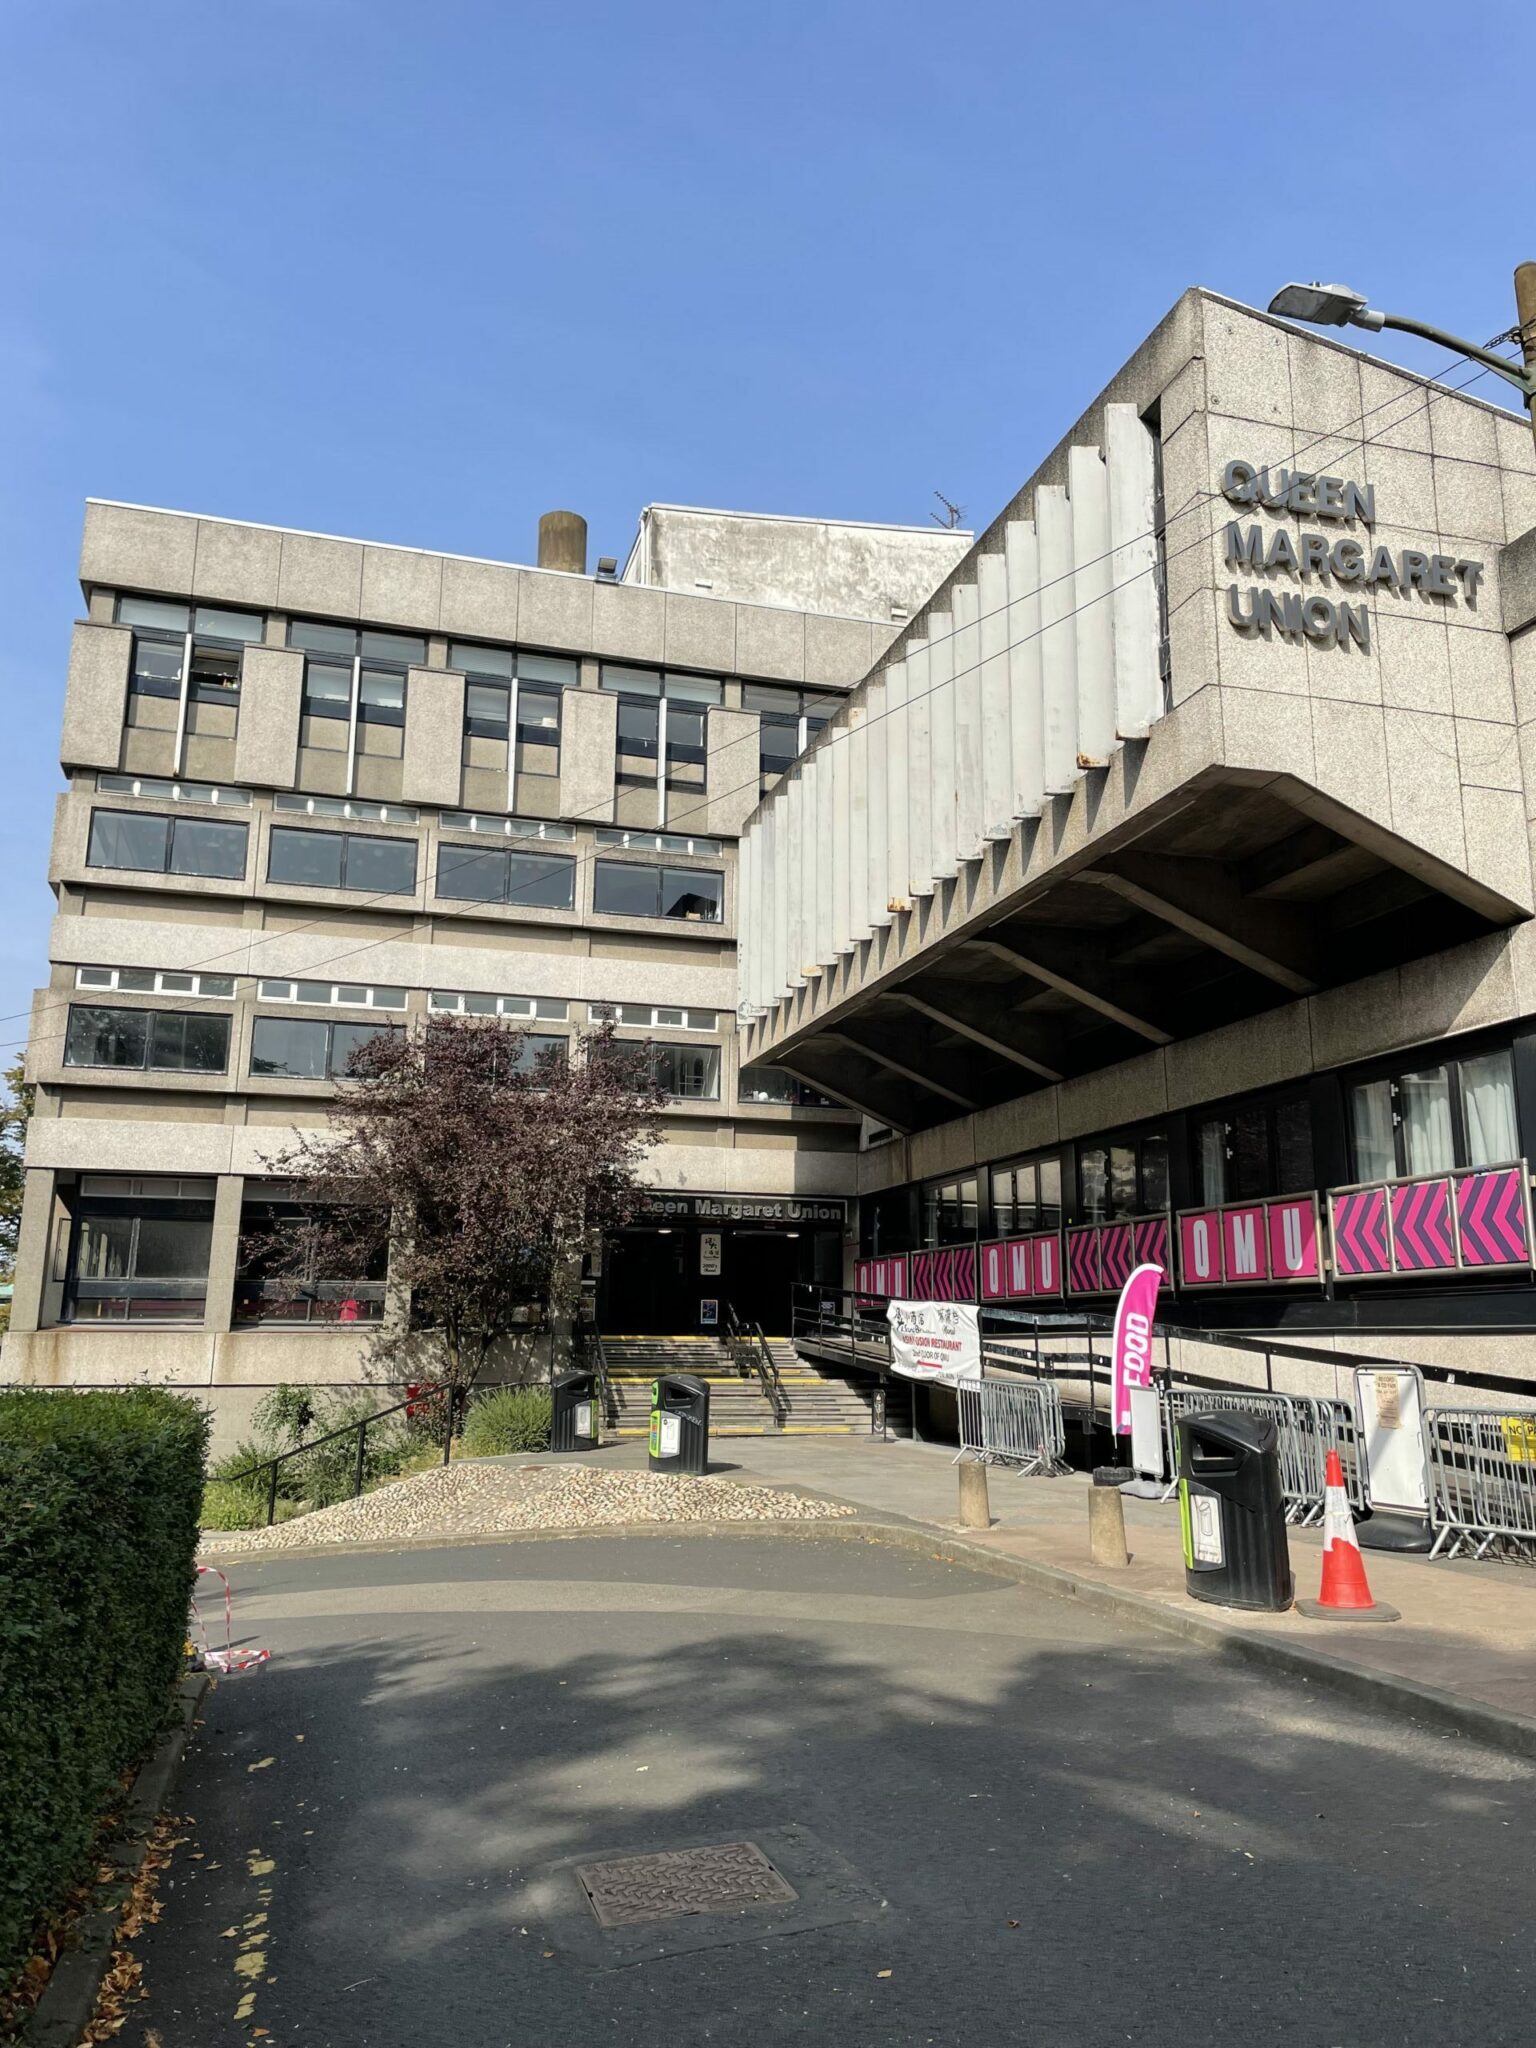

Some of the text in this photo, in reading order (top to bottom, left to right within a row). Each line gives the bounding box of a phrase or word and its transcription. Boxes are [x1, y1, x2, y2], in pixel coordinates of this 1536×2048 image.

[1222, 459, 1375, 523] QUEEN
[1224, 520, 1484, 600] MARGARET
[1226, 583, 1369, 644] UNION
[695, 1199, 782, 1219] Margaret
[787, 1202, 841, 1219] Union
[988, 1241, 1052, 1294] QMU
[1193, 1207, 1303, 1278] QMU
[931, 1338, 962, 1352] RESTAURANT
[1123, 1312, 1150, 1388] FOOD
[1508, 1425, 1523, 1435] NO
